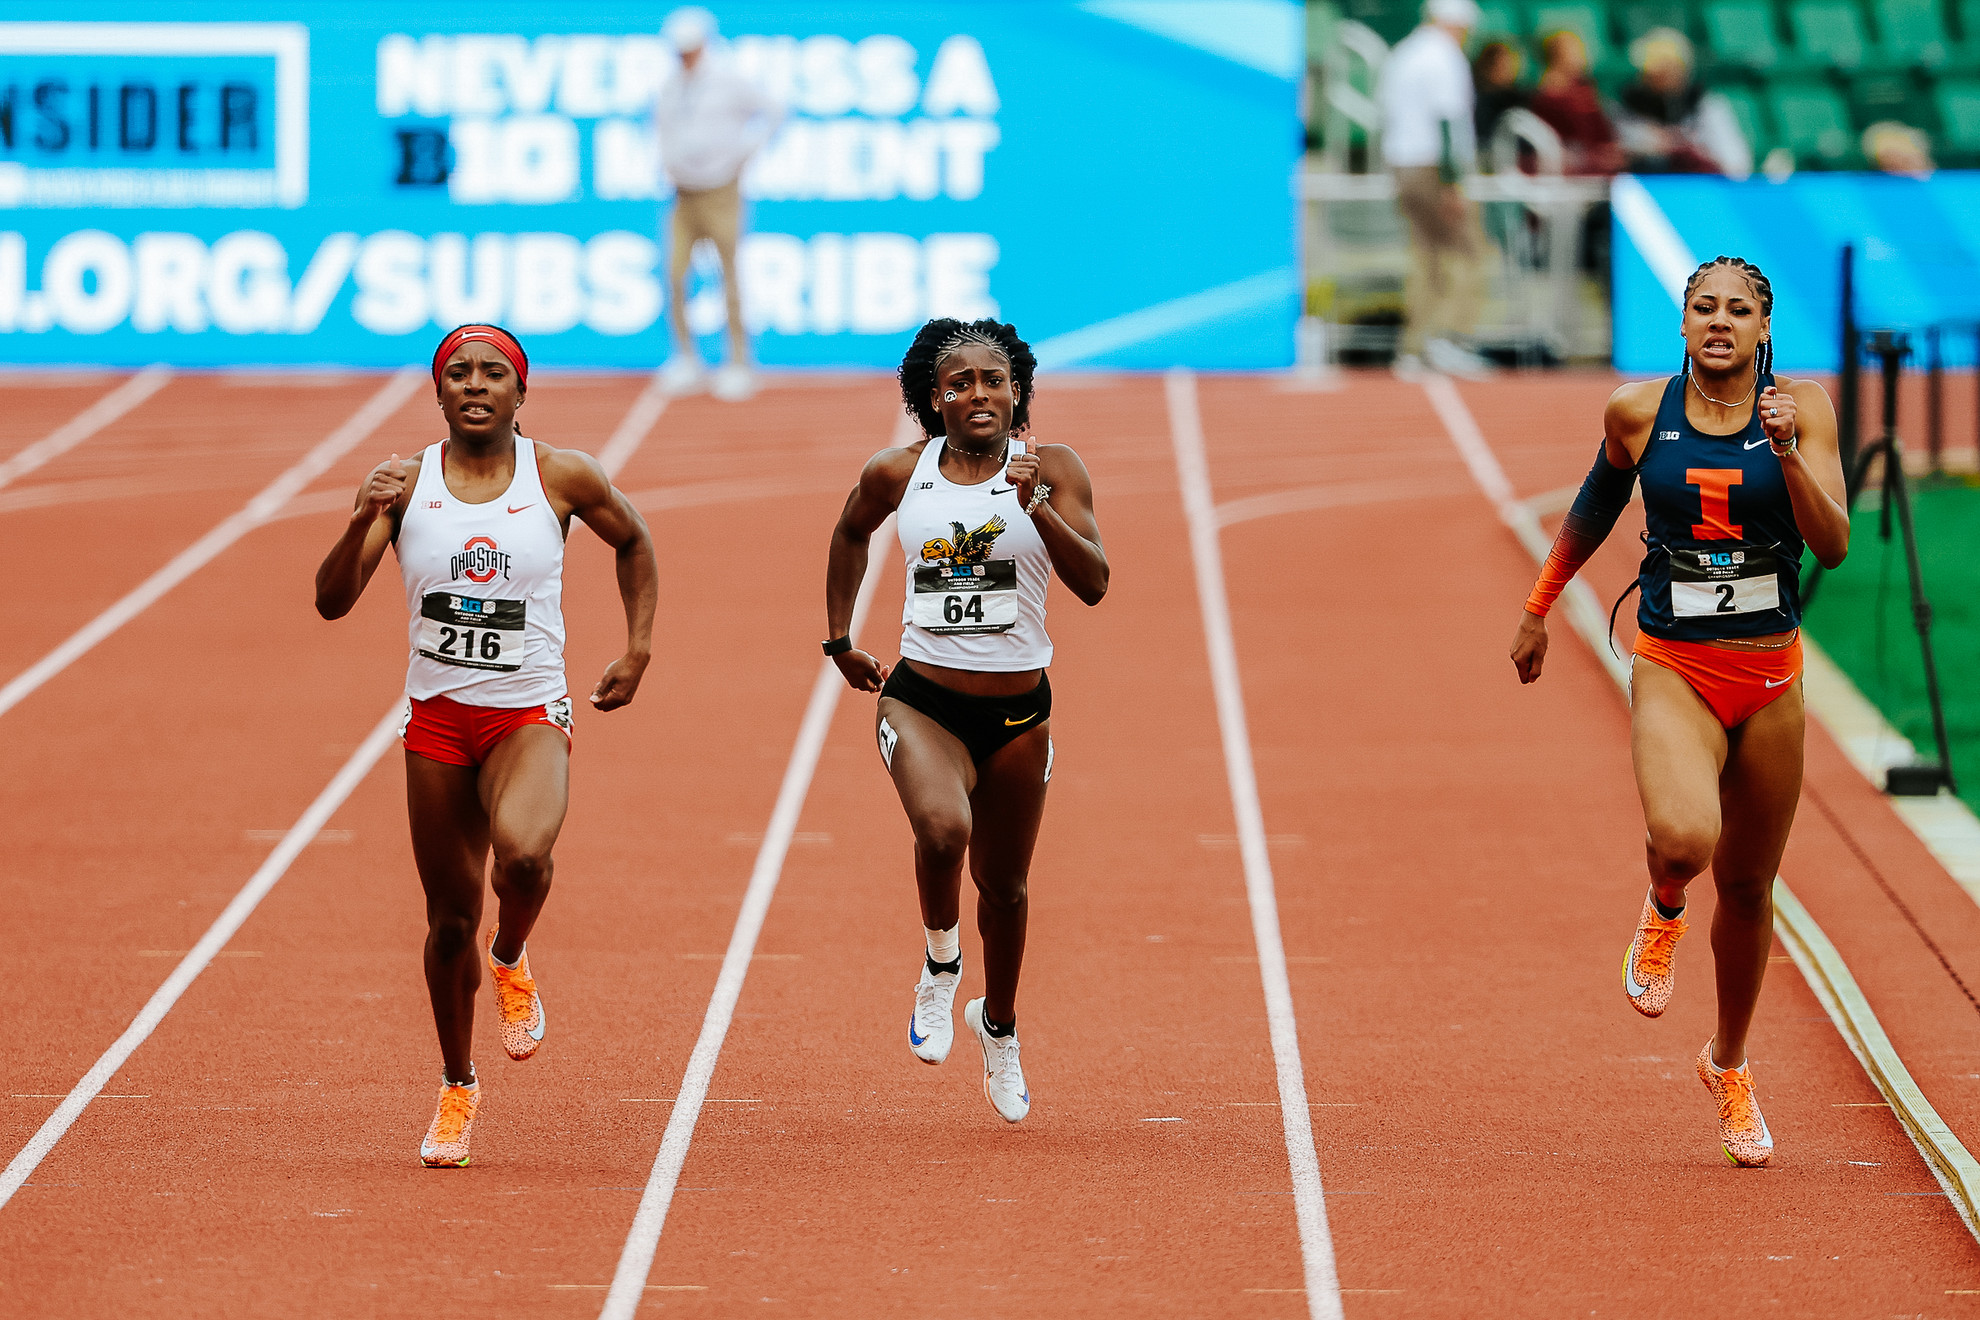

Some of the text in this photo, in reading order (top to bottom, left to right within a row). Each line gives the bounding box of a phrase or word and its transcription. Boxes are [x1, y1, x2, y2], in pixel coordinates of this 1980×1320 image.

[926, 35, 1000, 116] A
[595, 119, 1000, 200] MMENT
[943, 595, 984, 624] 64
[1715, 584, 1736, 612] 2
[438, 626, 501, 660] 216
